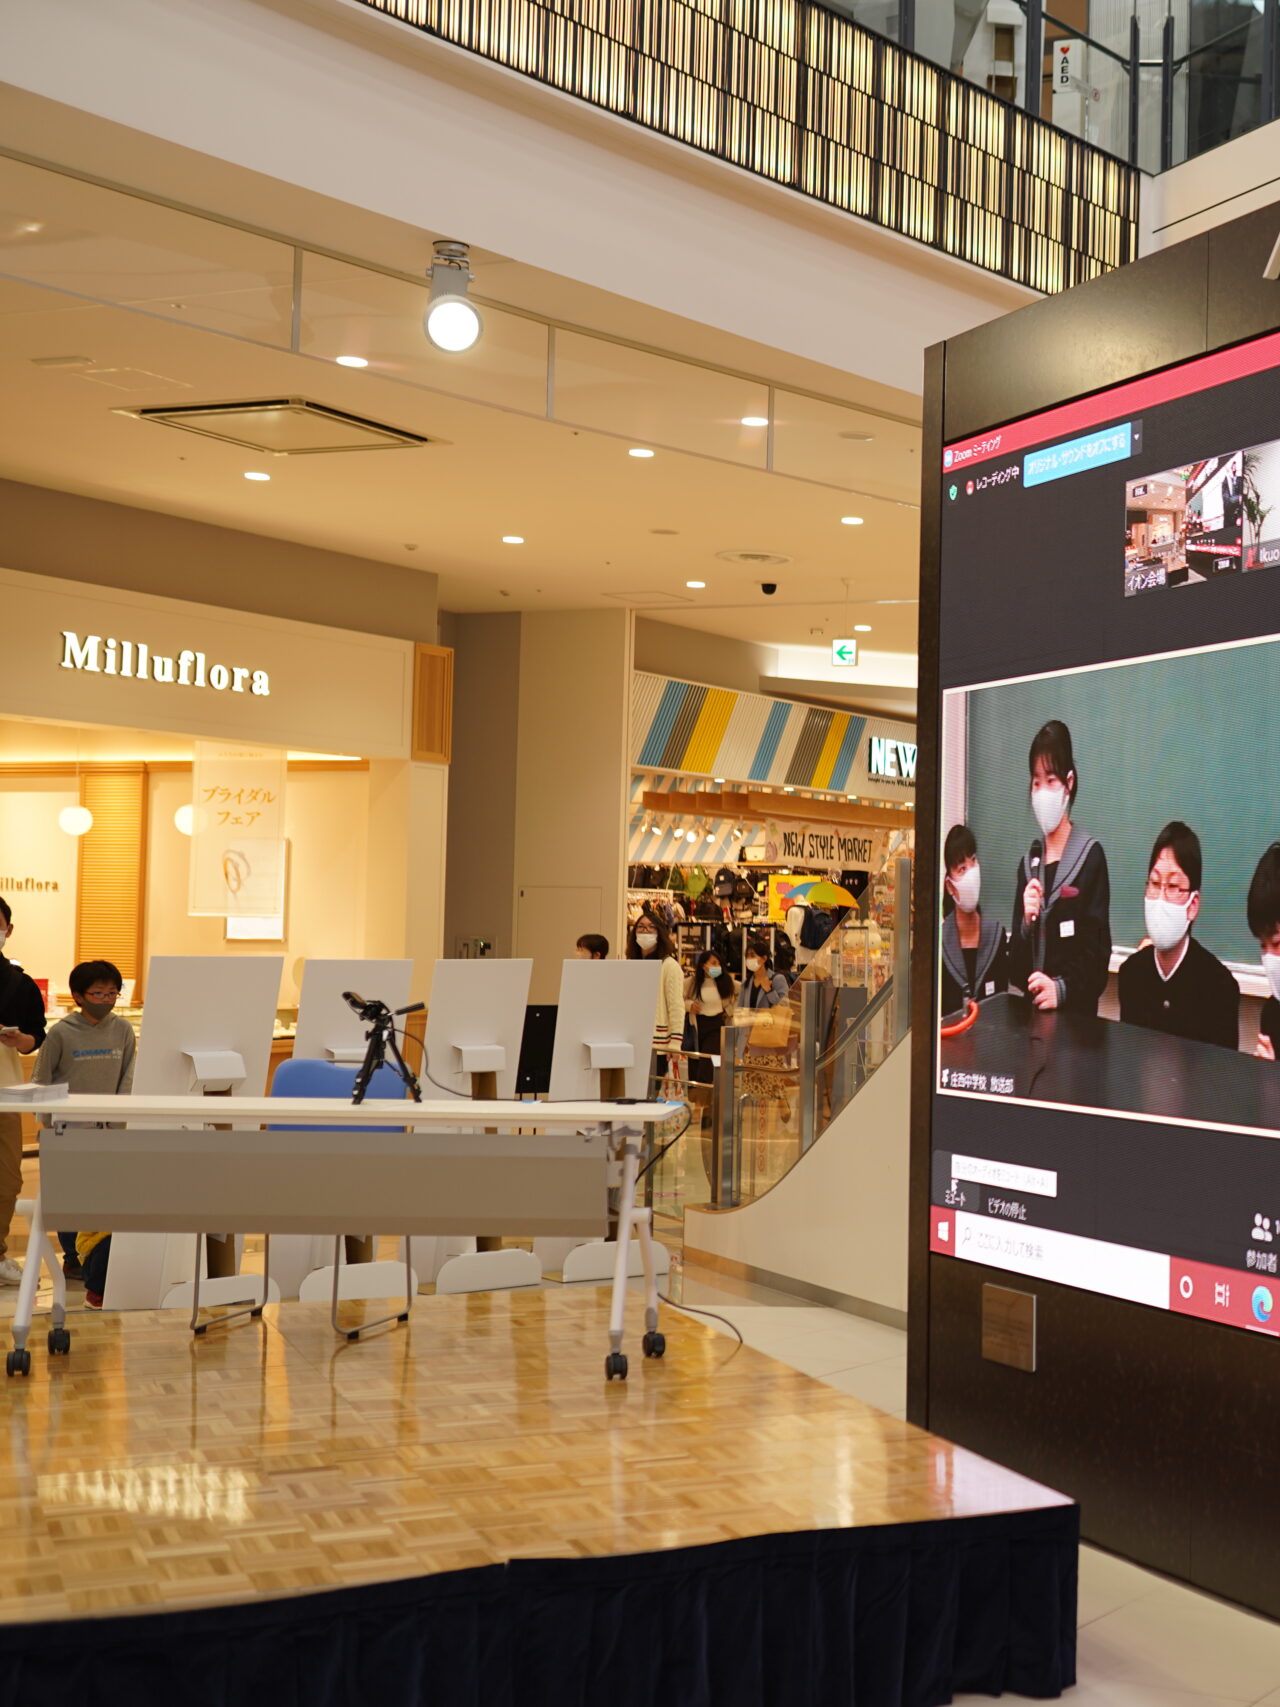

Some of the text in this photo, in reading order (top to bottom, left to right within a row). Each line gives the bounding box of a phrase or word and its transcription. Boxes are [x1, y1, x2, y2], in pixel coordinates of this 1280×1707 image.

[1060, 56, 1069, 84] AED
[1259, 544, 1280, 562] Ikuo
[1127, 568, 1167, 592] イオン会場
[60, 631, 270, 696] Milluflora
[868, 735, 917, 779] NEW
[203, 786, 276, 805] ブライダル
[217, 811, 261, 828] フェア
[783, 832, 872, 863] NEW STYLE MARKET
[0, 877, 59, 892] illuflora
[1246, 1249, 1278, 1273] 参加者
